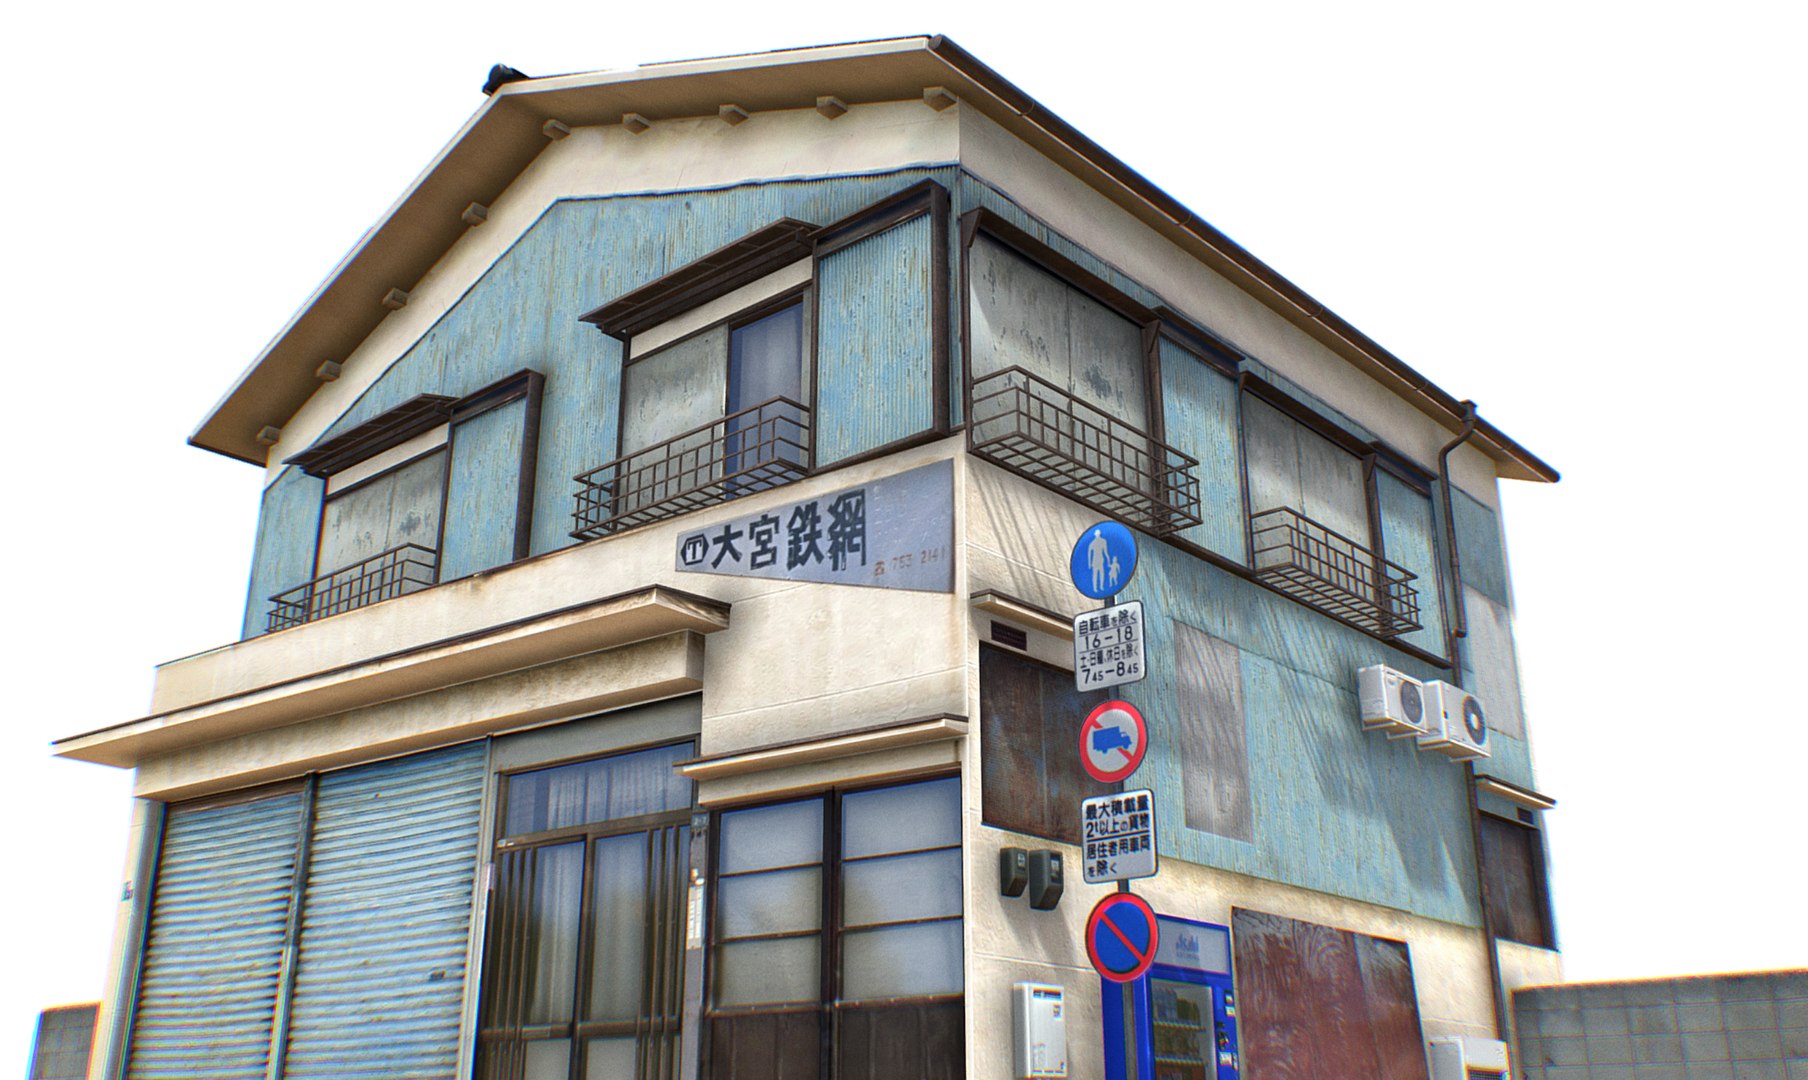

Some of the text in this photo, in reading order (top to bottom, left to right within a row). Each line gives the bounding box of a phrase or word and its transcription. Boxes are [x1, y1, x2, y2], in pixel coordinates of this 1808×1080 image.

[711, 488, 867, 572] 大宮鉄網
[1079, 609, 1138, 635] 自転車を除く
[1086, 794, 1149, 820] 最大積載量
[1087, 834, 1150, 859] 居住者用車両
[1088, 860, 1117, 877] を除く
